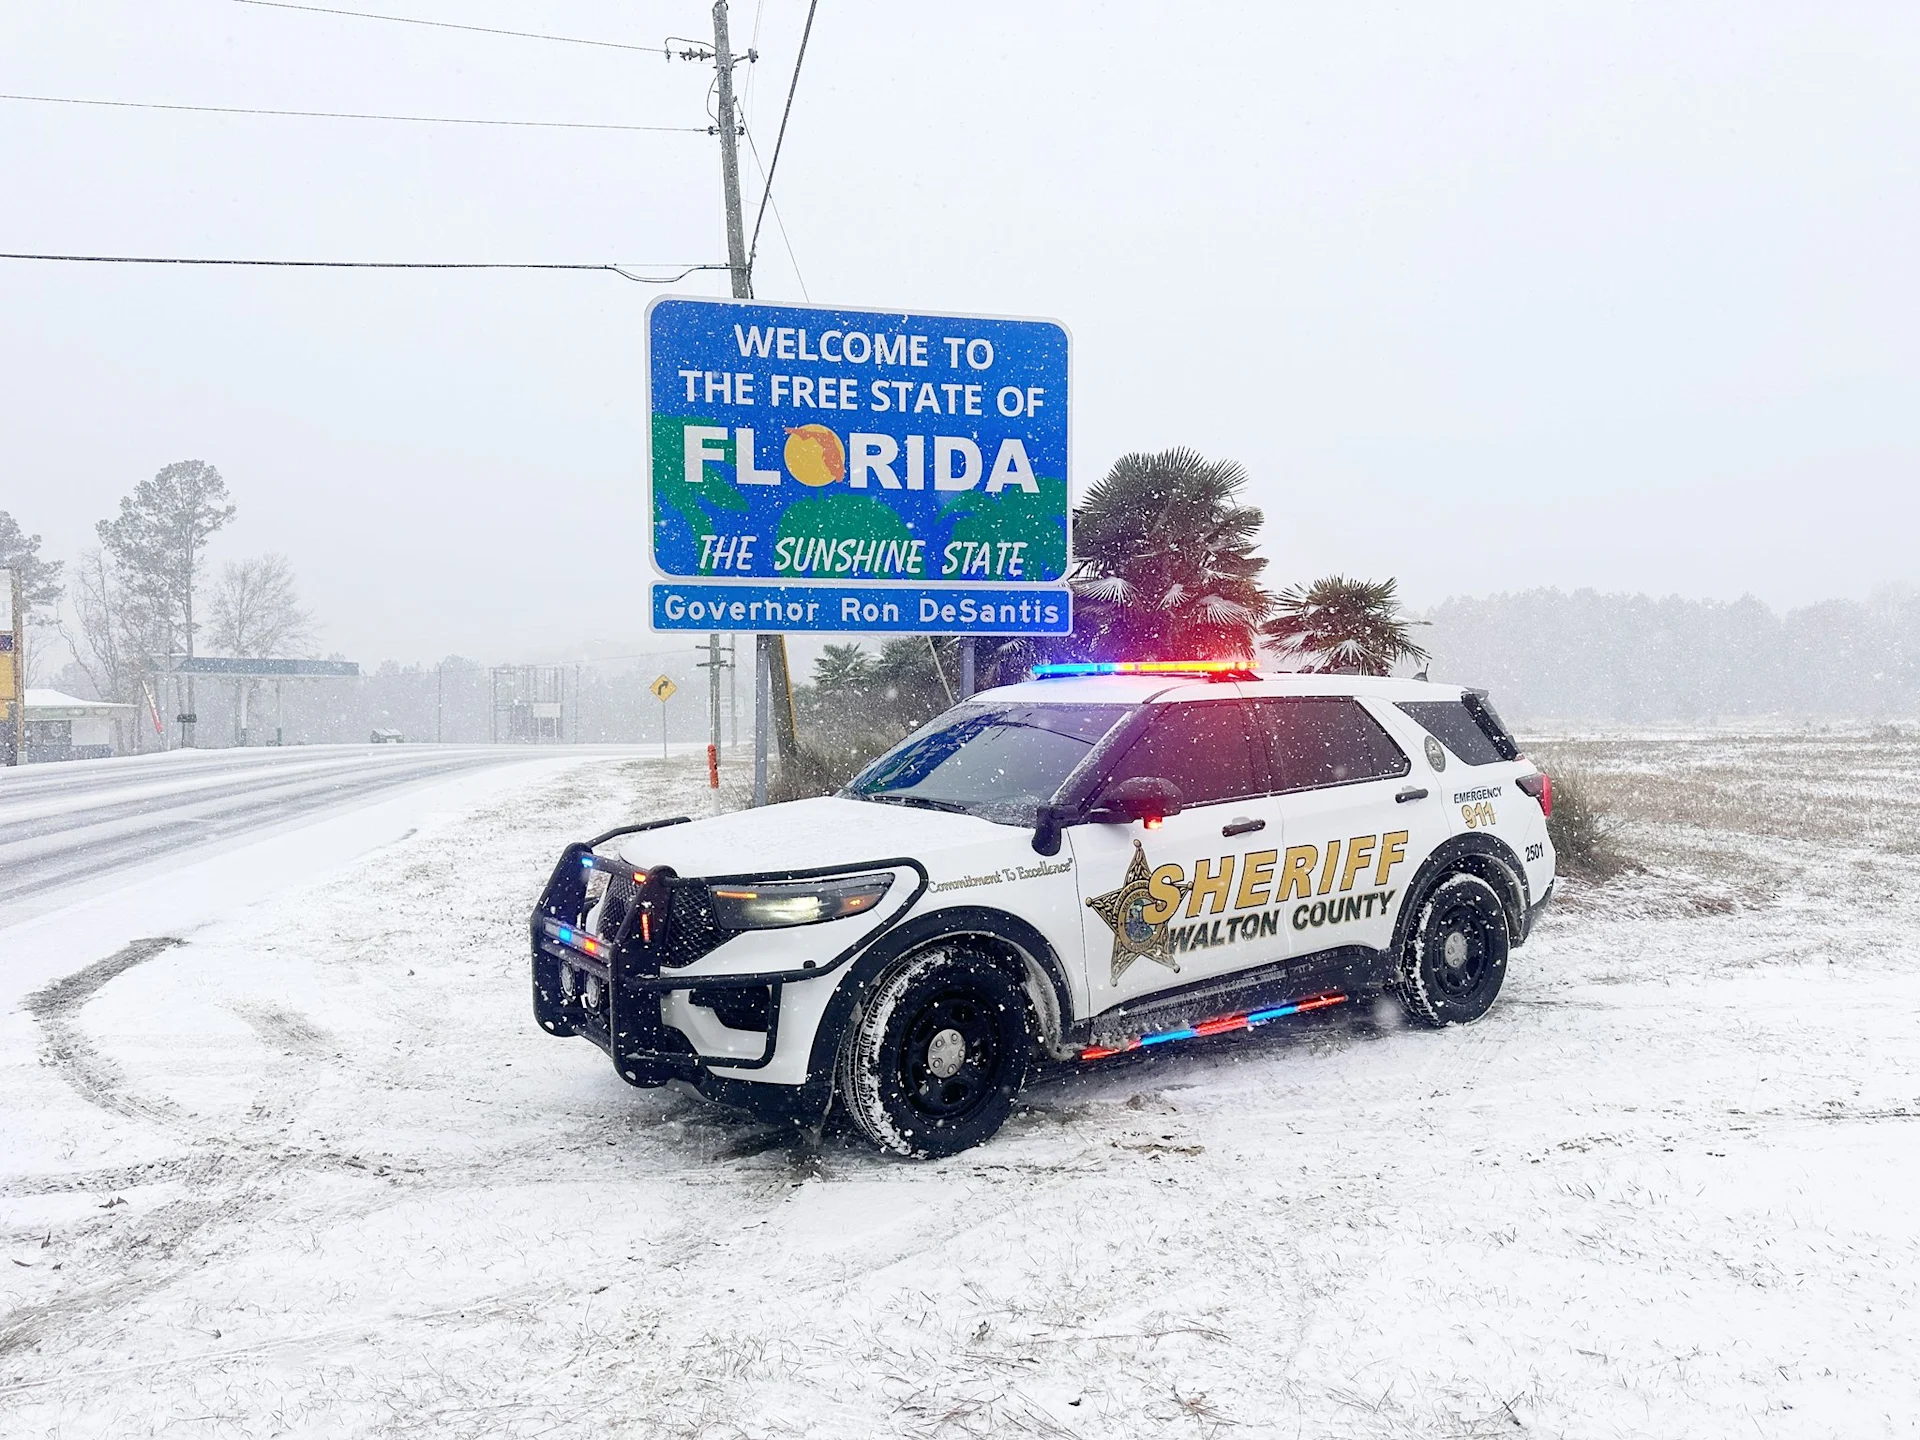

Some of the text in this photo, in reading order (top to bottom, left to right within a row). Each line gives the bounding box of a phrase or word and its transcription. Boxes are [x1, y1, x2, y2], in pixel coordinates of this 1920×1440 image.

[734, 324, 995, 370] WELCOME TO
[678, 369, 1046, 418] THE FREE STATE OF
[683, 423, 1041, 494] FLORIDA
[700, 534, 1028, 576] THE SUNSHINE STATE
[665, 594, 1060, 625] Governor Ron DeSantis
[1454, 786, 1502, 804] EMERGENCY
[1461, 802, 1496, 829] 911
[1525, 842, 1545, 863] 2501
[928, 870, 1002, 894] Commitment
[1002, 868, 1017, 882] To
[1143, 830, 1410, 925] SHERIFF
[1168, 890, 1398, 955] WALTON COUNTY
